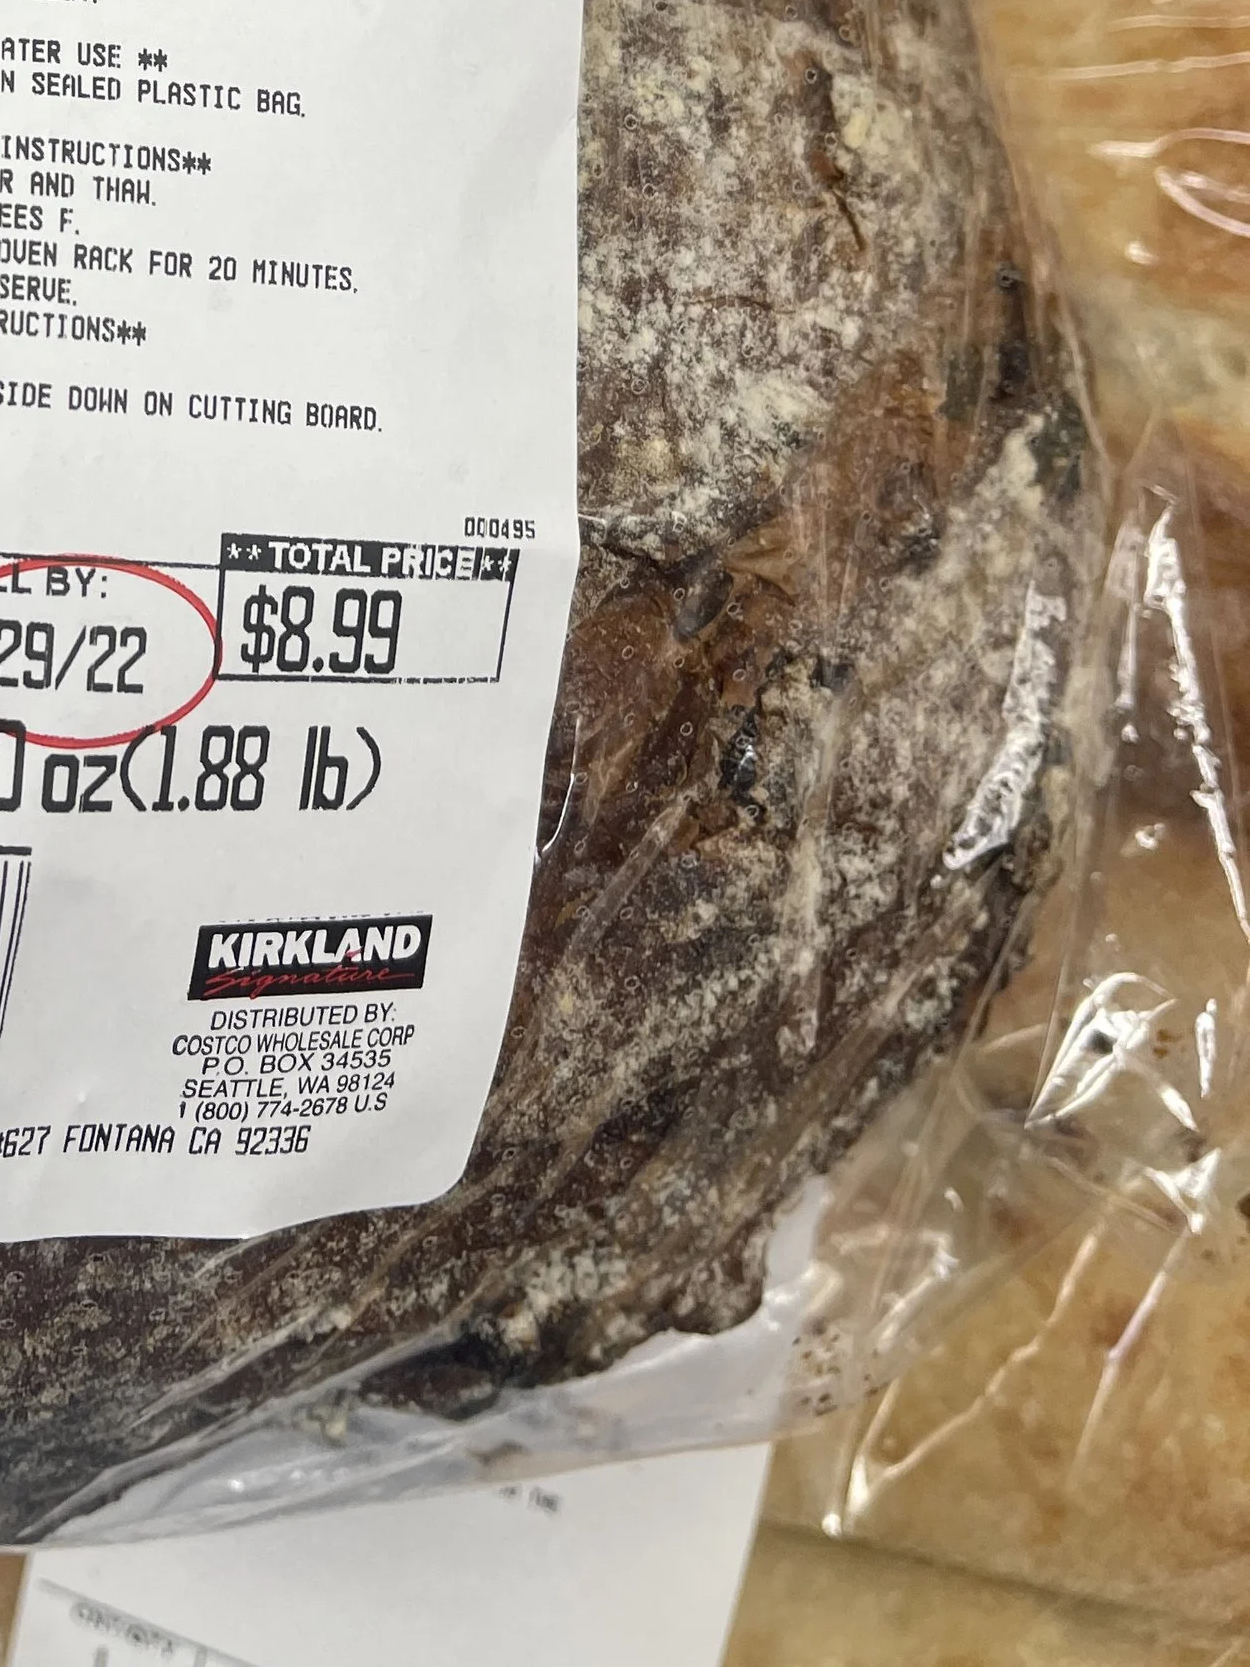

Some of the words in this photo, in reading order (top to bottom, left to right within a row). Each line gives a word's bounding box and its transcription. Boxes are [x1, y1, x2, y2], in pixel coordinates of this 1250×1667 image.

[77, 41, 122, 69] USE
[31, 71, 122, 101] SEALED
[137, 78, 242, 111] PLASTIC
[256, 88, 306, 118] BAG.
[30, 170, 75, 199] AND
[92, 175, 157, 207] THAW.
[73, 243, 134, 274] RACK
[149, 249, 193, 279] FOR
[208, 255, 238, 282] 20
[252, 258, 358, 294] MINUTES.
[68, 385, 128, 414] DOWN
[143, 390, 173, 417] ON
[188, 393, 292, 426] CUTTING
[305, 401, 382, 433] BOARD.
[268, 540, 372, 573] TOTAL
[46, 566, 108, 599] BY:
[240, 584, 403, 674] $8.99
[208, 924, 422, 968] KIRKLAND
[203, 964, 414, 999] Signature
[210, 1004, 357, 1030] DISTRIBUTED
[172, 1034, 250, 1056] COSTCO
[257, 1028, 363, 1053] WHOLESALE
[367, 1024, 414, 1047] CORP
[201, 1056, 249, 1076] P.O.
[260, 1052, 314, 1074] BOX
[321, 1049, 392, 1072] 34535
[181, 1076, 288, 1100] SEATTLE,
[298, 1075, 330, 1095] WA
[336, 1071, 395, 1094] 98124
[195, 1101, 249, 1123] (800)
[257, 1096, 348, 1119] 774-2678
[62, 1123, 176, 1155] FONTANA
[188, 1126, 222, 1154] CA
[234, 1124, 312, 1155] 92336
